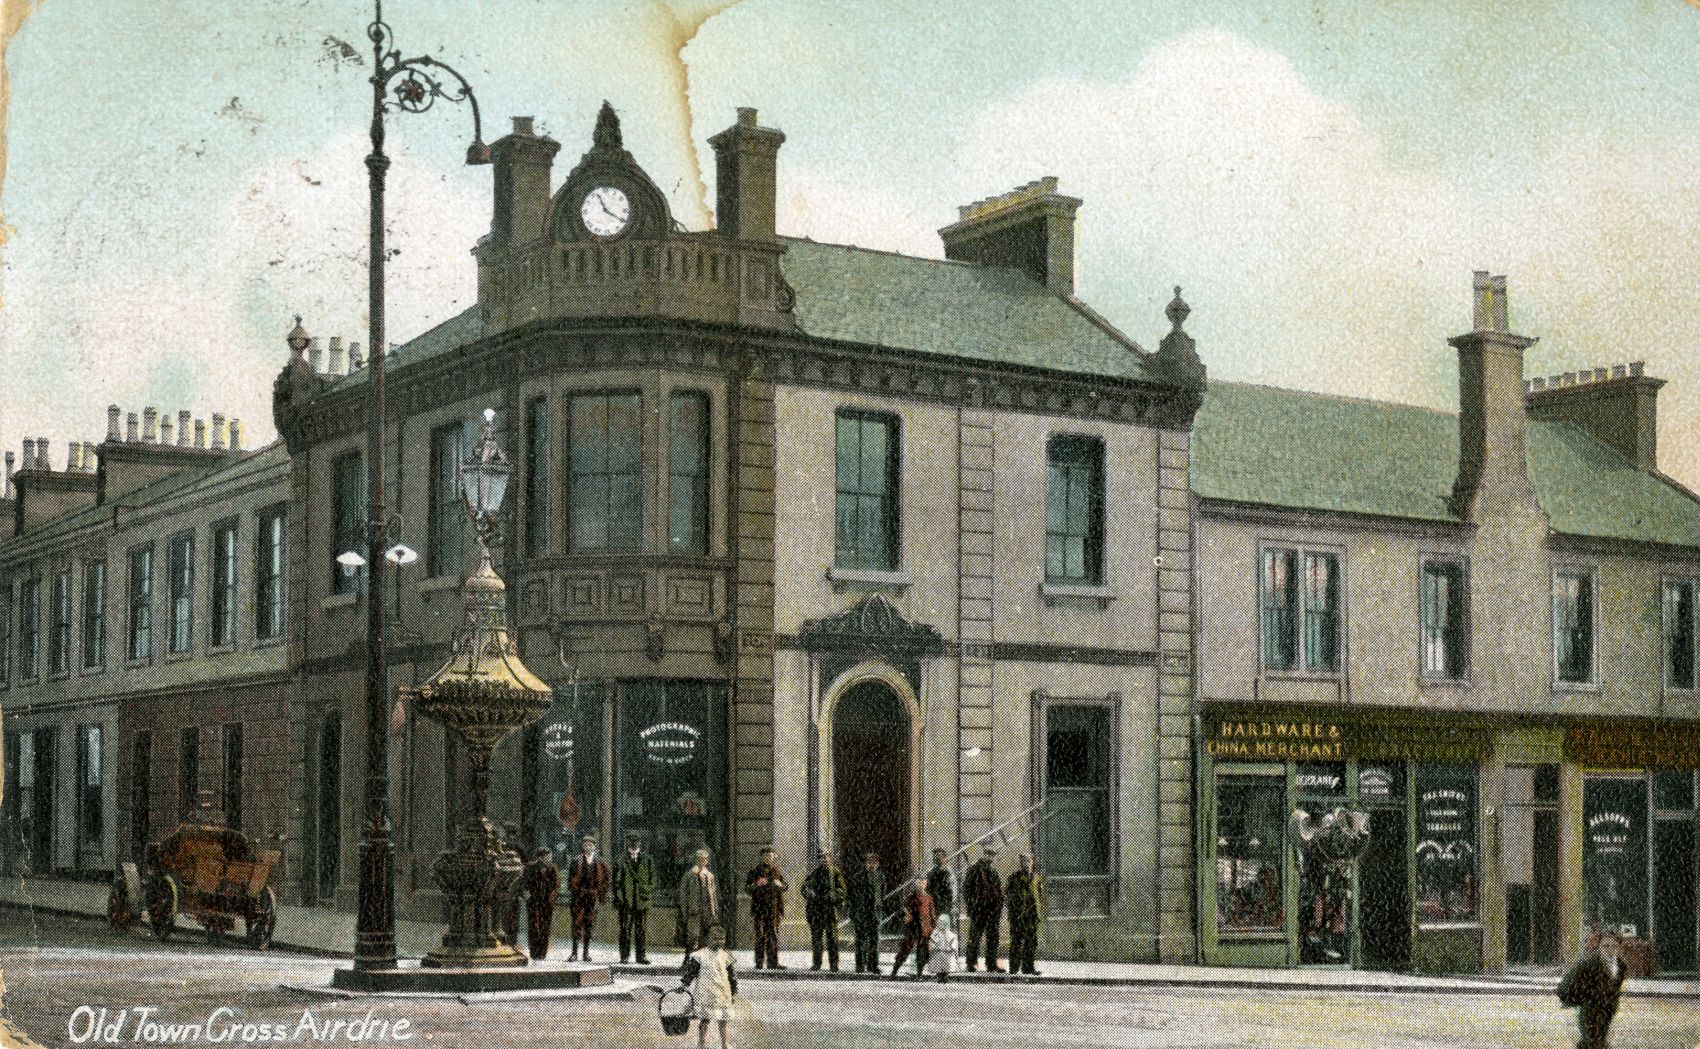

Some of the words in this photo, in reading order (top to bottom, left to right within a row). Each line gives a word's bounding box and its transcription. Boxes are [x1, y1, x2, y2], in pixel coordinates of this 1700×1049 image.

[640, 722, 701, 740] PHOTOGRAPHIC
[1222, 721, 1322, 738] HARDWARE
[1328, 725, 1340, 738] &
[648, 739, 695, 749] MATERIALS
[1205, 740, 1248, 756] CHINA
[1256, 741, 1342, 757] MERCHANT
